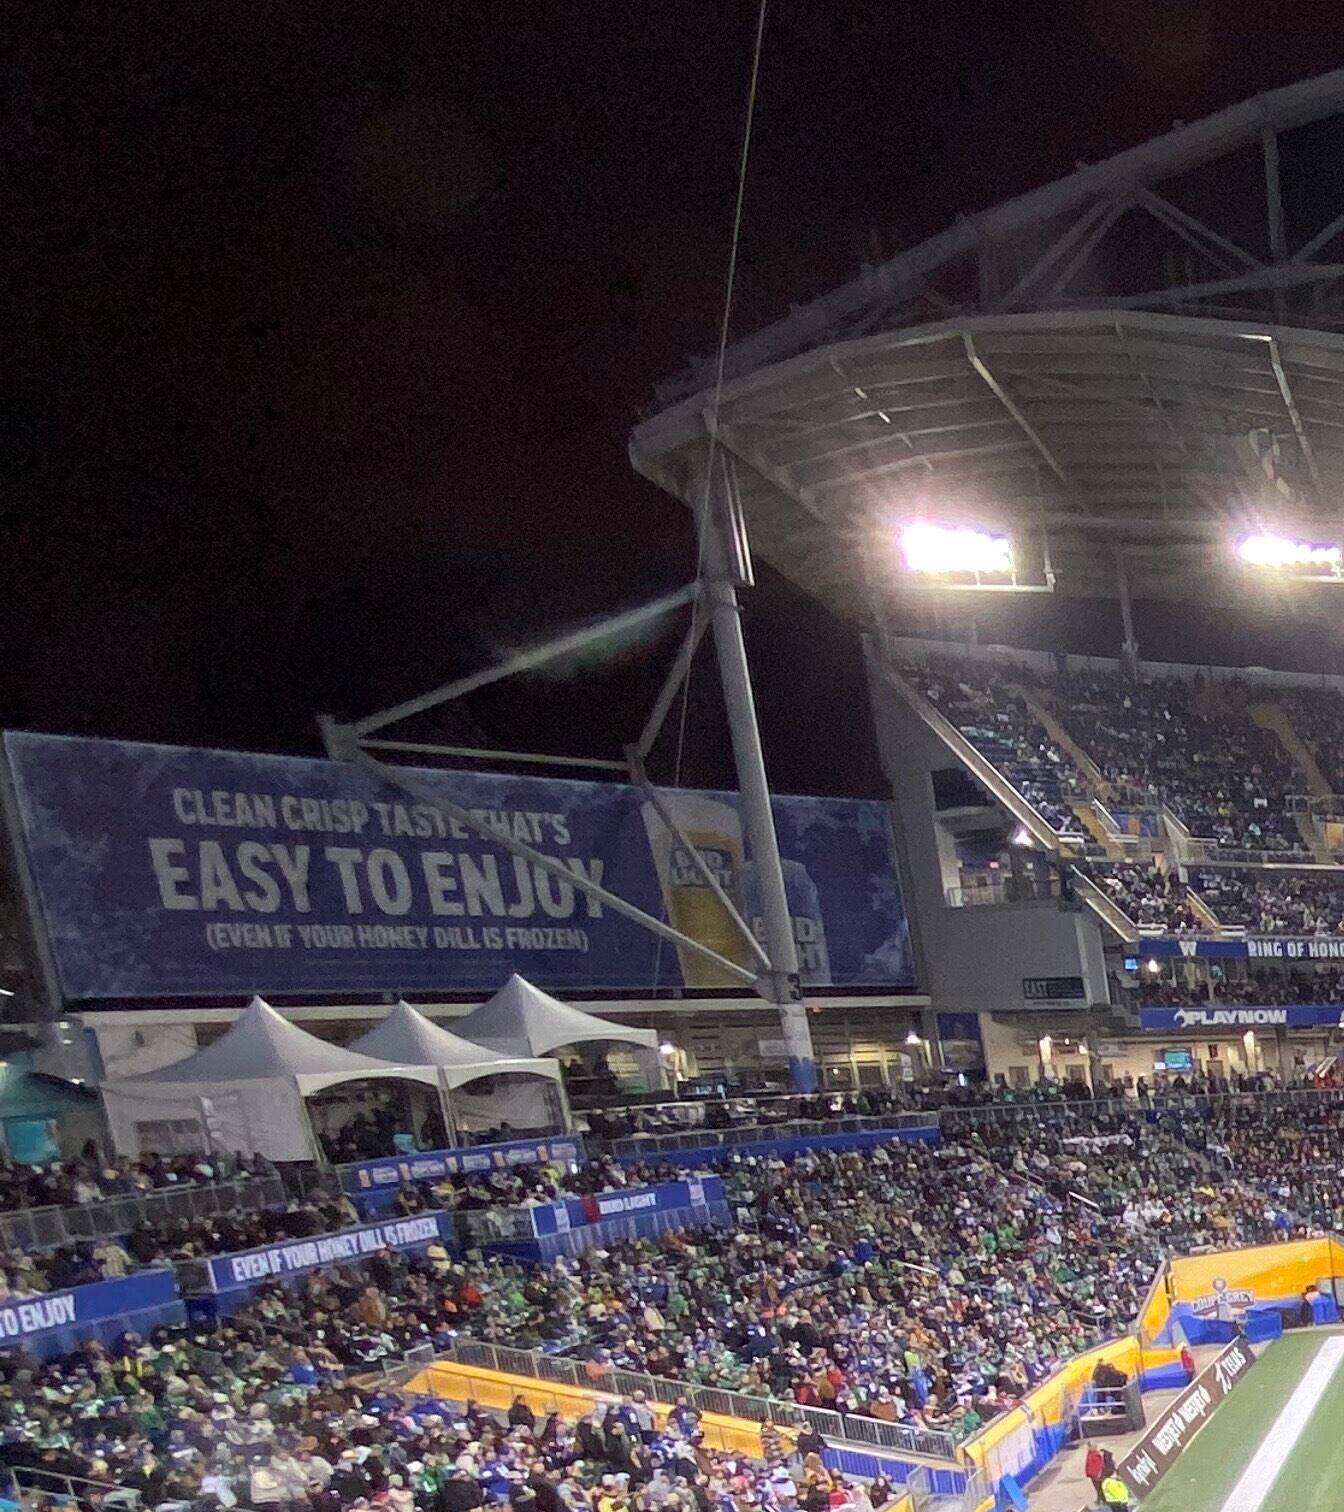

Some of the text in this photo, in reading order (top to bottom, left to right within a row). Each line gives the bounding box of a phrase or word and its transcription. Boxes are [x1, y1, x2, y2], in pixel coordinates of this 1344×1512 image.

[173, 788, 571, 845] CLEAN CRISP TASTE THAT'S
[148, 837, 603, 918] EASY TO ENJOY
[206, 922, 590, 954] (EVEN IF YOUR HONEY DILL IS FROZEN)
[1179, 940, 1198, 957] W
[1248, 940, 1284, 958] RING
[1286, 941, 1305, 958] OF
[1186, 1010, 1288, 1025] PLAYNOW
[231, 1253, 270, 1283] EVEN
[282, 1243, 320, 1271] YOUR
[319, 1231, 362, 1264] HONEY
[397, 1218, 441, 1245] FROZEN
[18, 1295, 77, 1333] ENJOY
